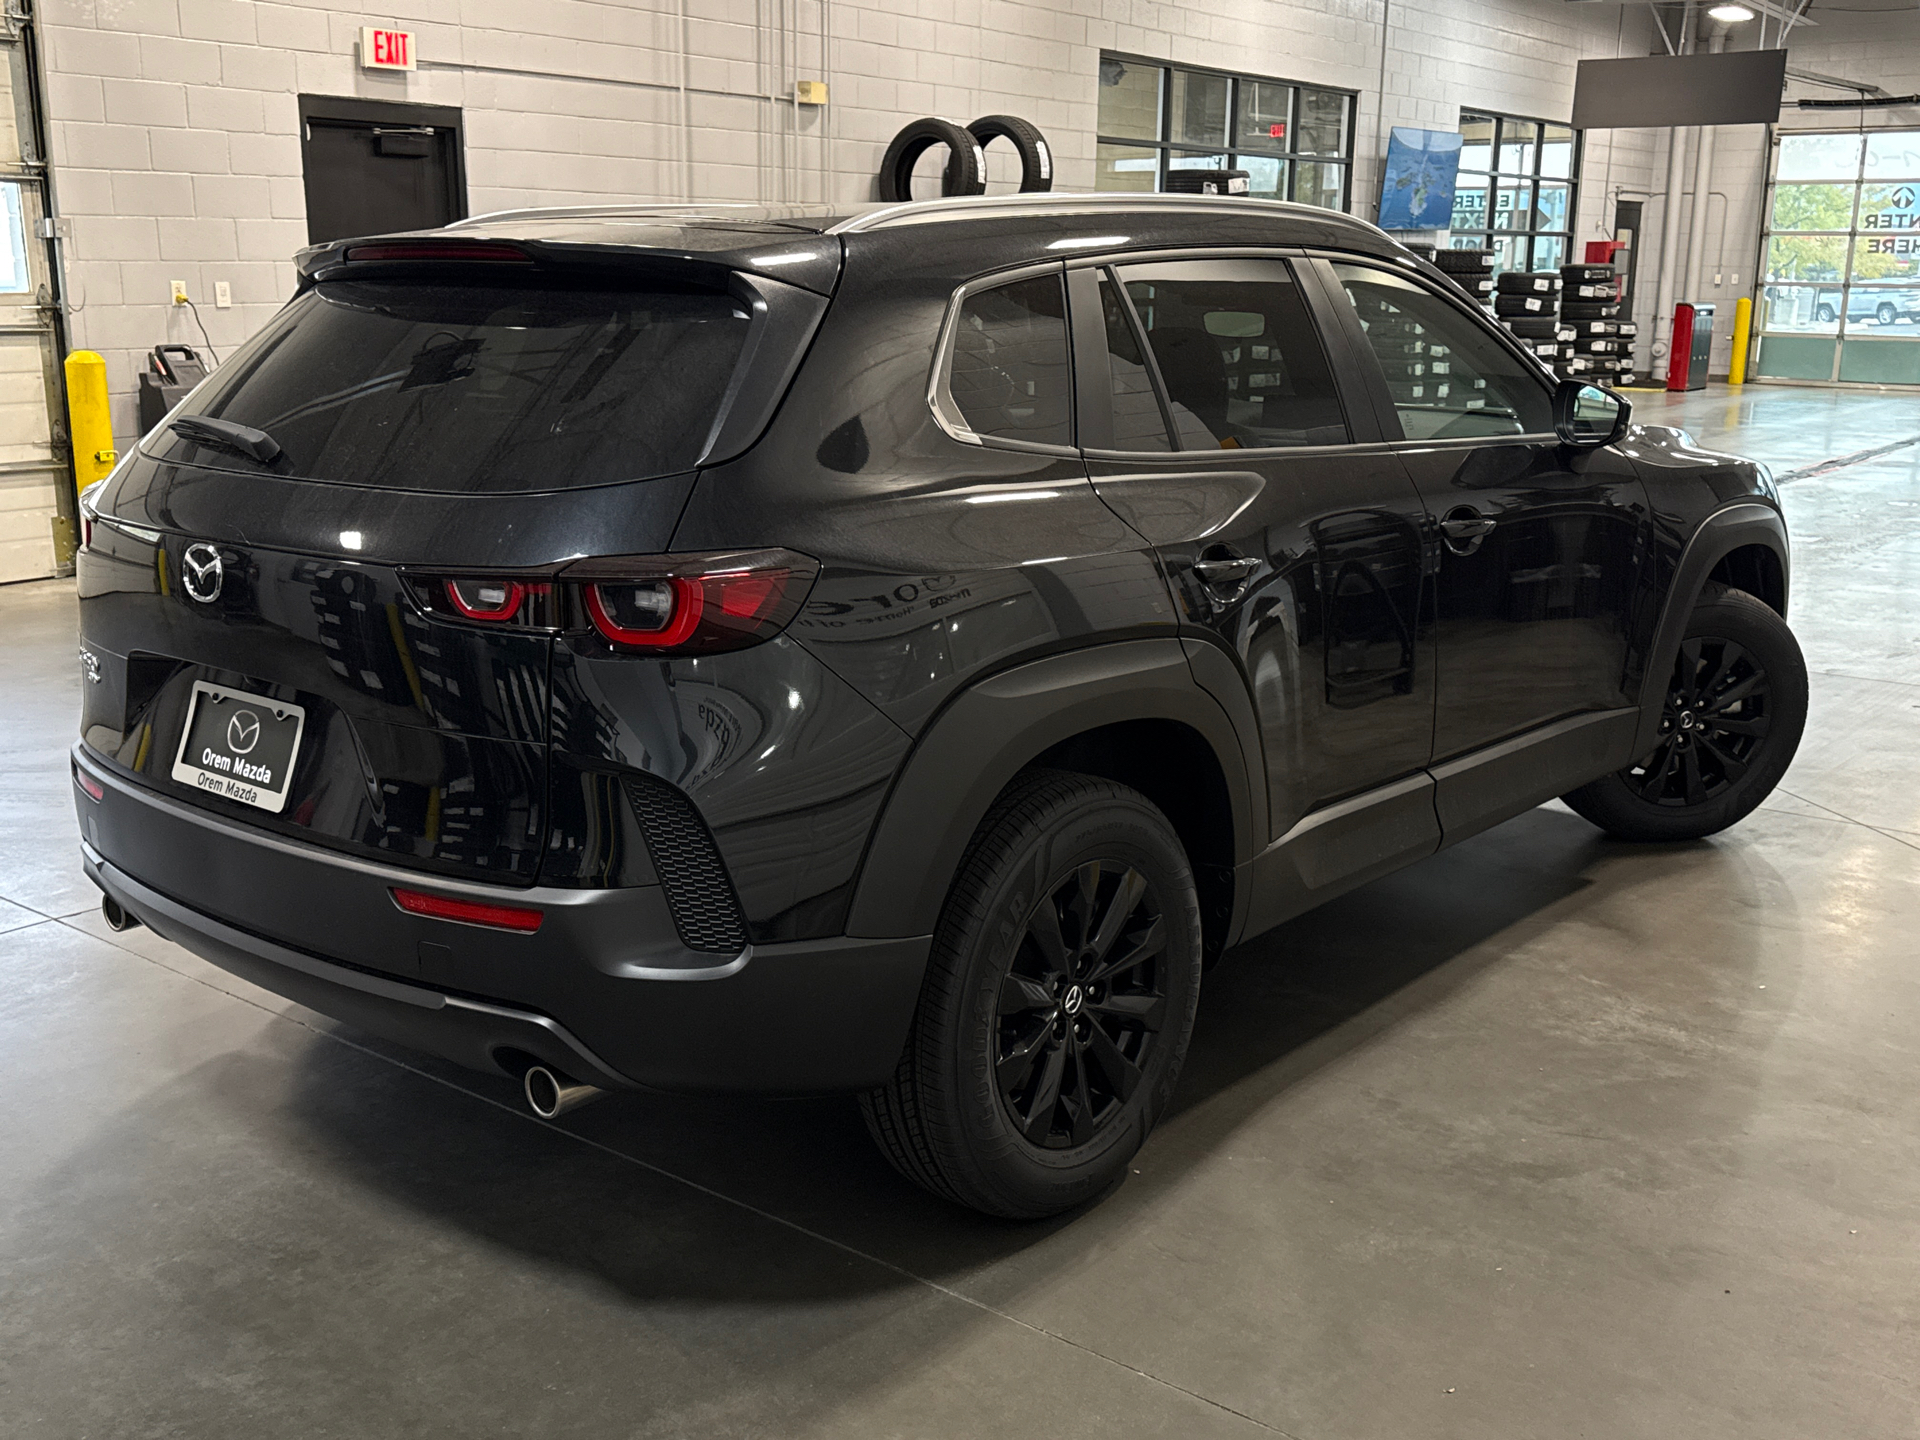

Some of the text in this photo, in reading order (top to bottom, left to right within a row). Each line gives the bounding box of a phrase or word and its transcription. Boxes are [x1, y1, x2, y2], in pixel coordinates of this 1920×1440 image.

[373, 29, 408, 67] EXIT
[203, 748, 272, 784] Orem Mazda
[197, 772, 258, 803] Orem Mazda
